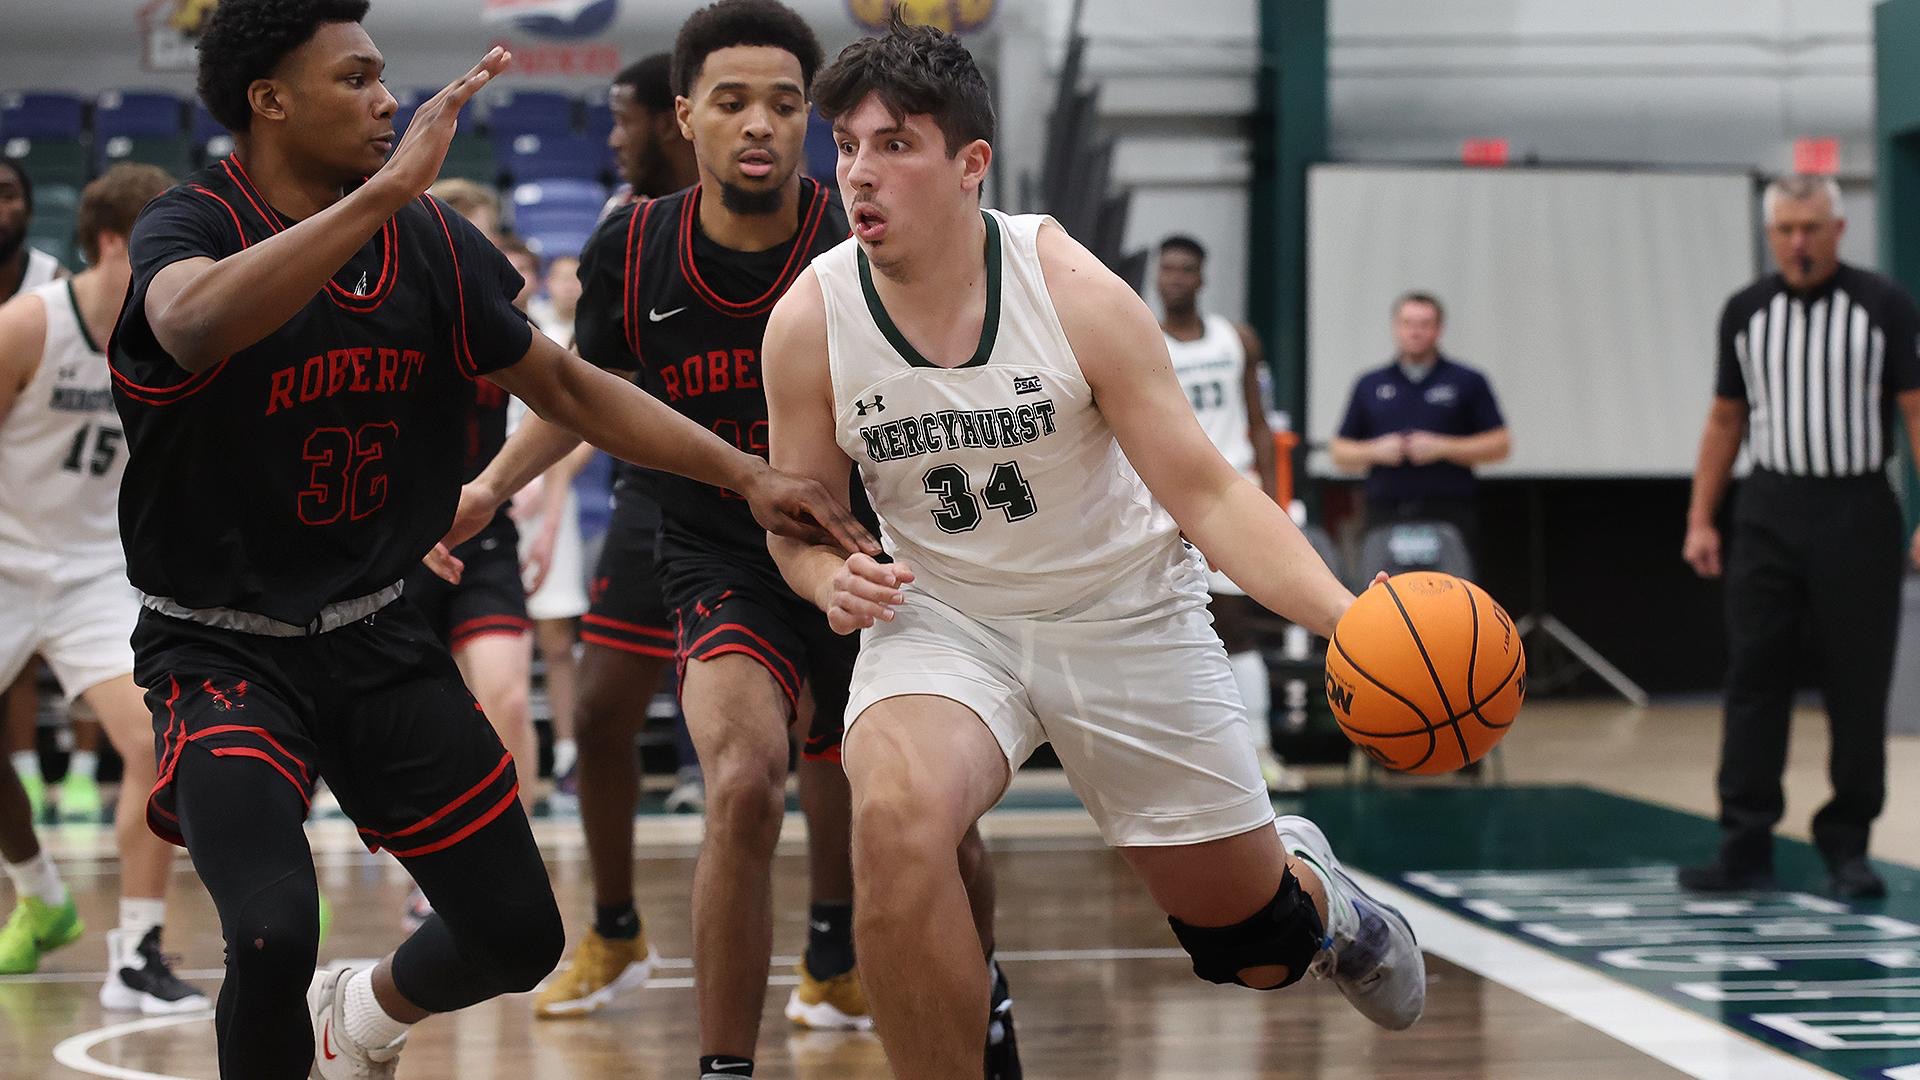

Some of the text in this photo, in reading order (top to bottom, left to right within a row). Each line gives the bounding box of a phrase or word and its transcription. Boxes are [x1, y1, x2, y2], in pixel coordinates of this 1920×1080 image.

[265, 347, 426, 416] ROBERT
[660, 348, 760, 401] ROBE
[1014, 379, 1042, 391] PSAC
[63, 423, 123, 476] 15
[860, 399, 1056, 463] MERCYHURST
[298, 420, 399, 525] 32
[922, 461, 1037, 534] 34
